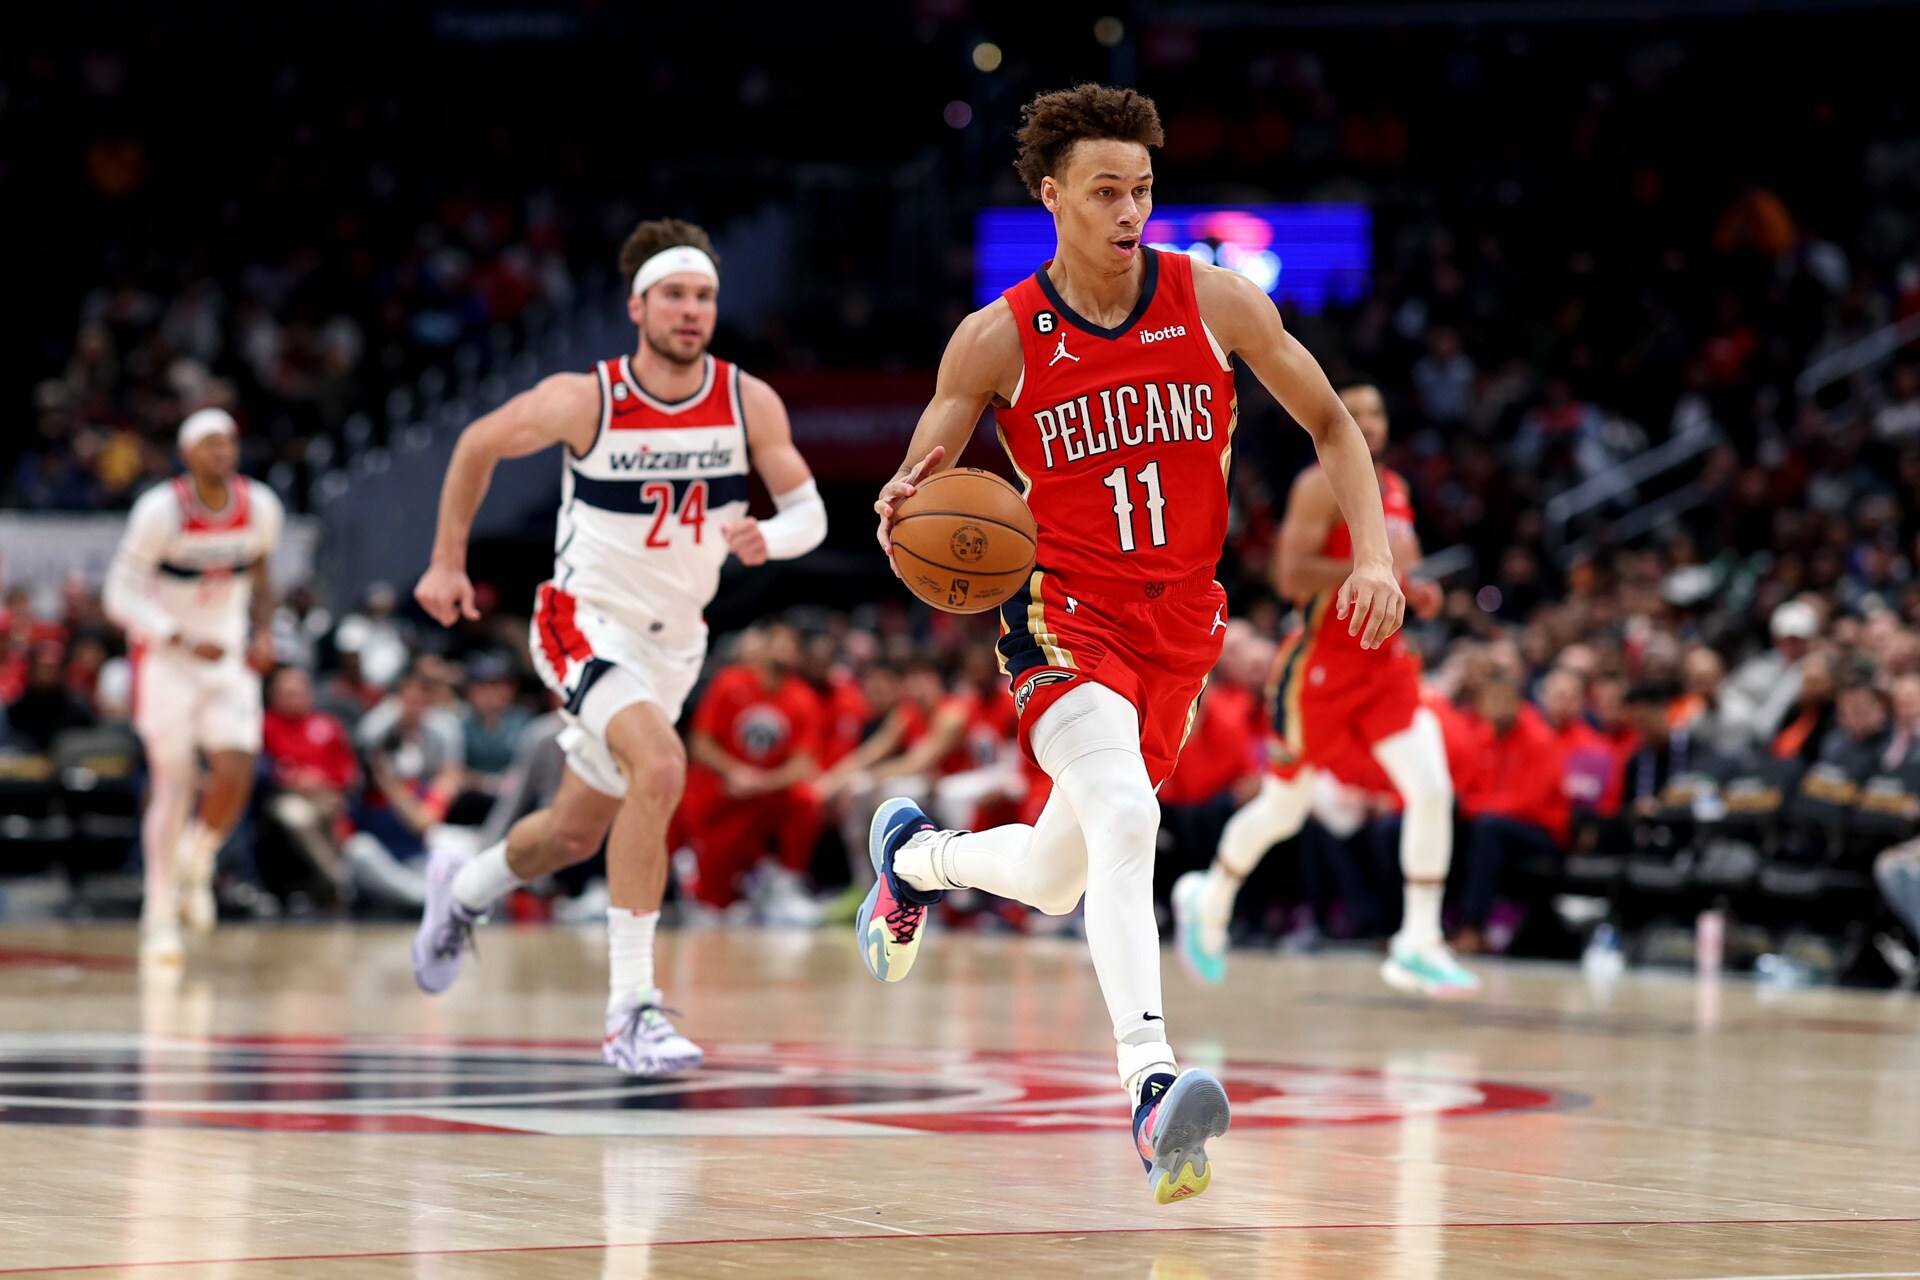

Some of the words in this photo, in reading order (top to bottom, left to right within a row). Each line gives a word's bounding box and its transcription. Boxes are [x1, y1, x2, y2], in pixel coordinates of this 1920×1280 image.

[1037, 313, 1053, 333] 6
[1139, 325, 1187, 345] ibotta
[1034, 382, 1214, 469] PELICANS
[609, 440, 733, 470] wizards
[642, 481, 706, 548] 24
[1103, 460, 1167, 552] 11
